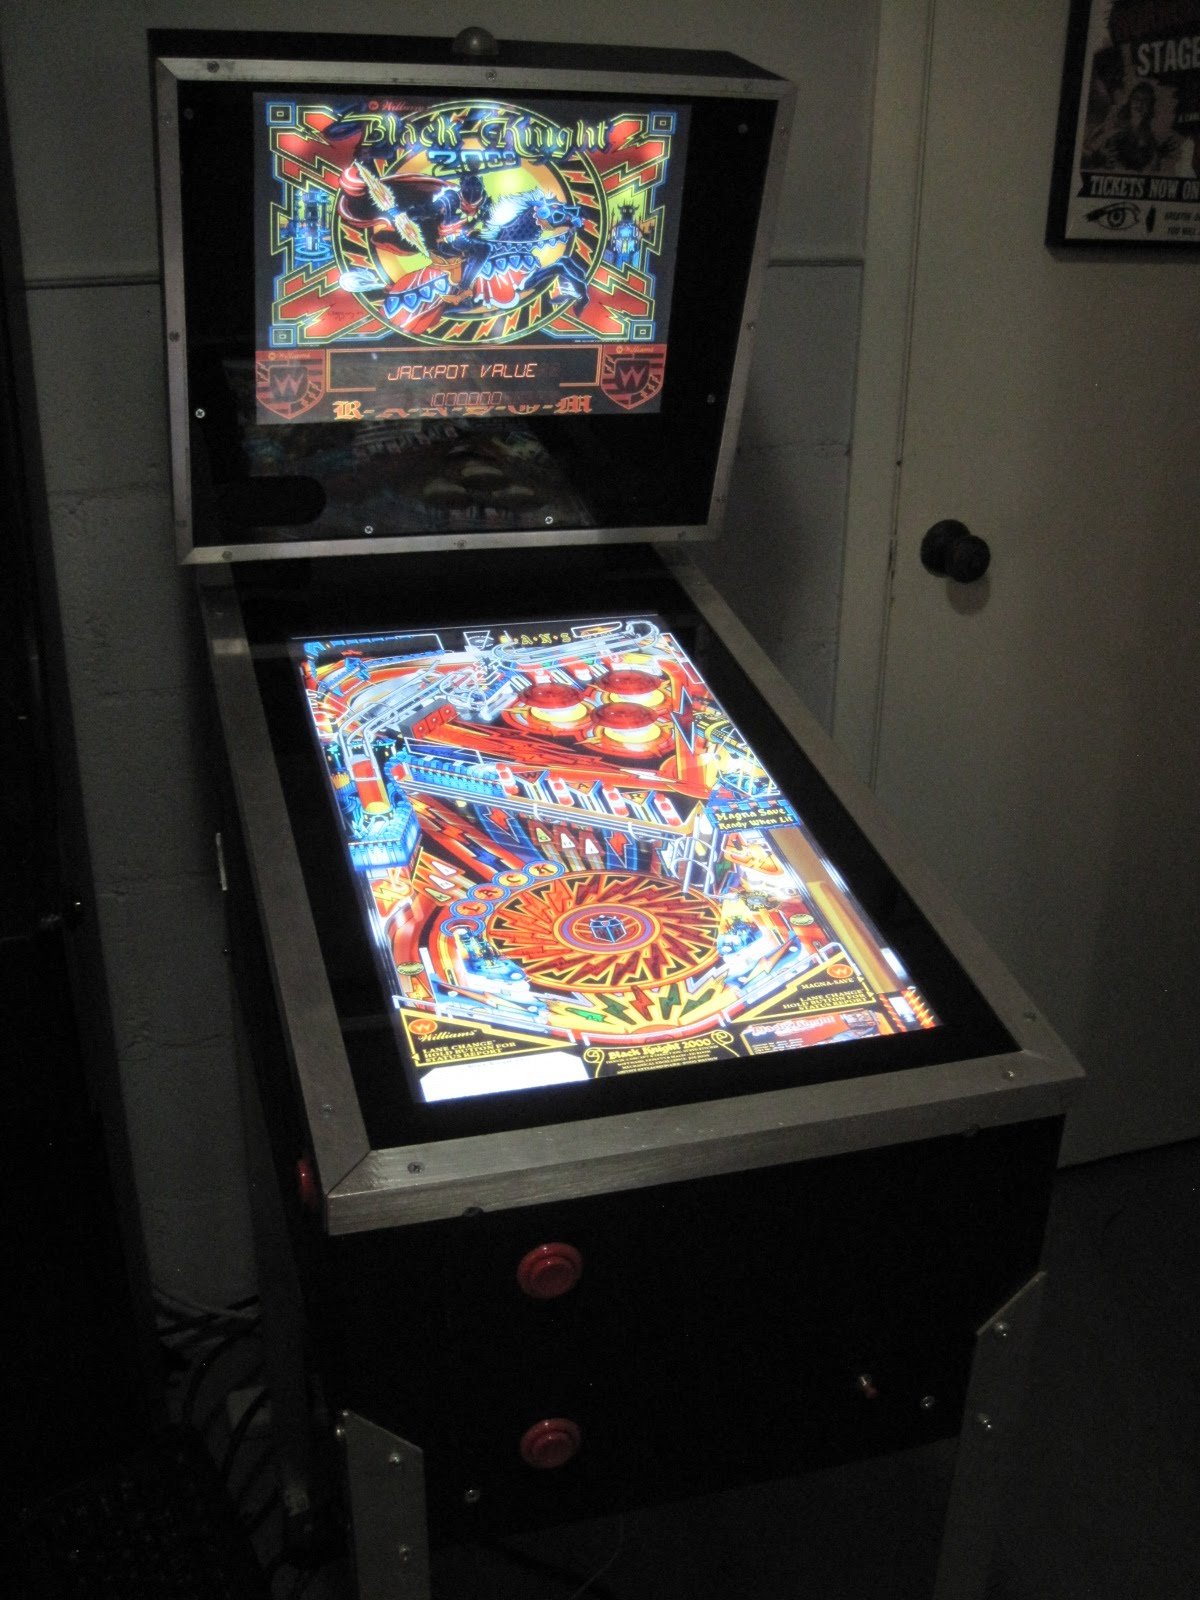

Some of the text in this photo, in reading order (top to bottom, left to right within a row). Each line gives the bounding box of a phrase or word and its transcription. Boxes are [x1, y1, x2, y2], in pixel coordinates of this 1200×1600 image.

[355, 112, 609, 159] Black Knight
[428, 149, 517, 176] 2000
[1090, 175, 1145, 198] TICKETS
[1149, 178, 1180, 199] NOW
[388, 363, 538, 381] JACKPOT VALUE
[715, 807, 786, 821] Magna Save
[718, 815, 793, 830] Ready When Lit
[801, 978, 855, 990] MAGNA-SAVE
[823, 989, 863, 999] CHANGE
[418, 1030, 478, 1042] Williams
[422, 1040, 495, 1054] LANE CHANGE
[608, 1048, 641, 1060] Black
[642, 1042, 681, 1055] Knight
[681, 1038, 712, 1049] 2000
